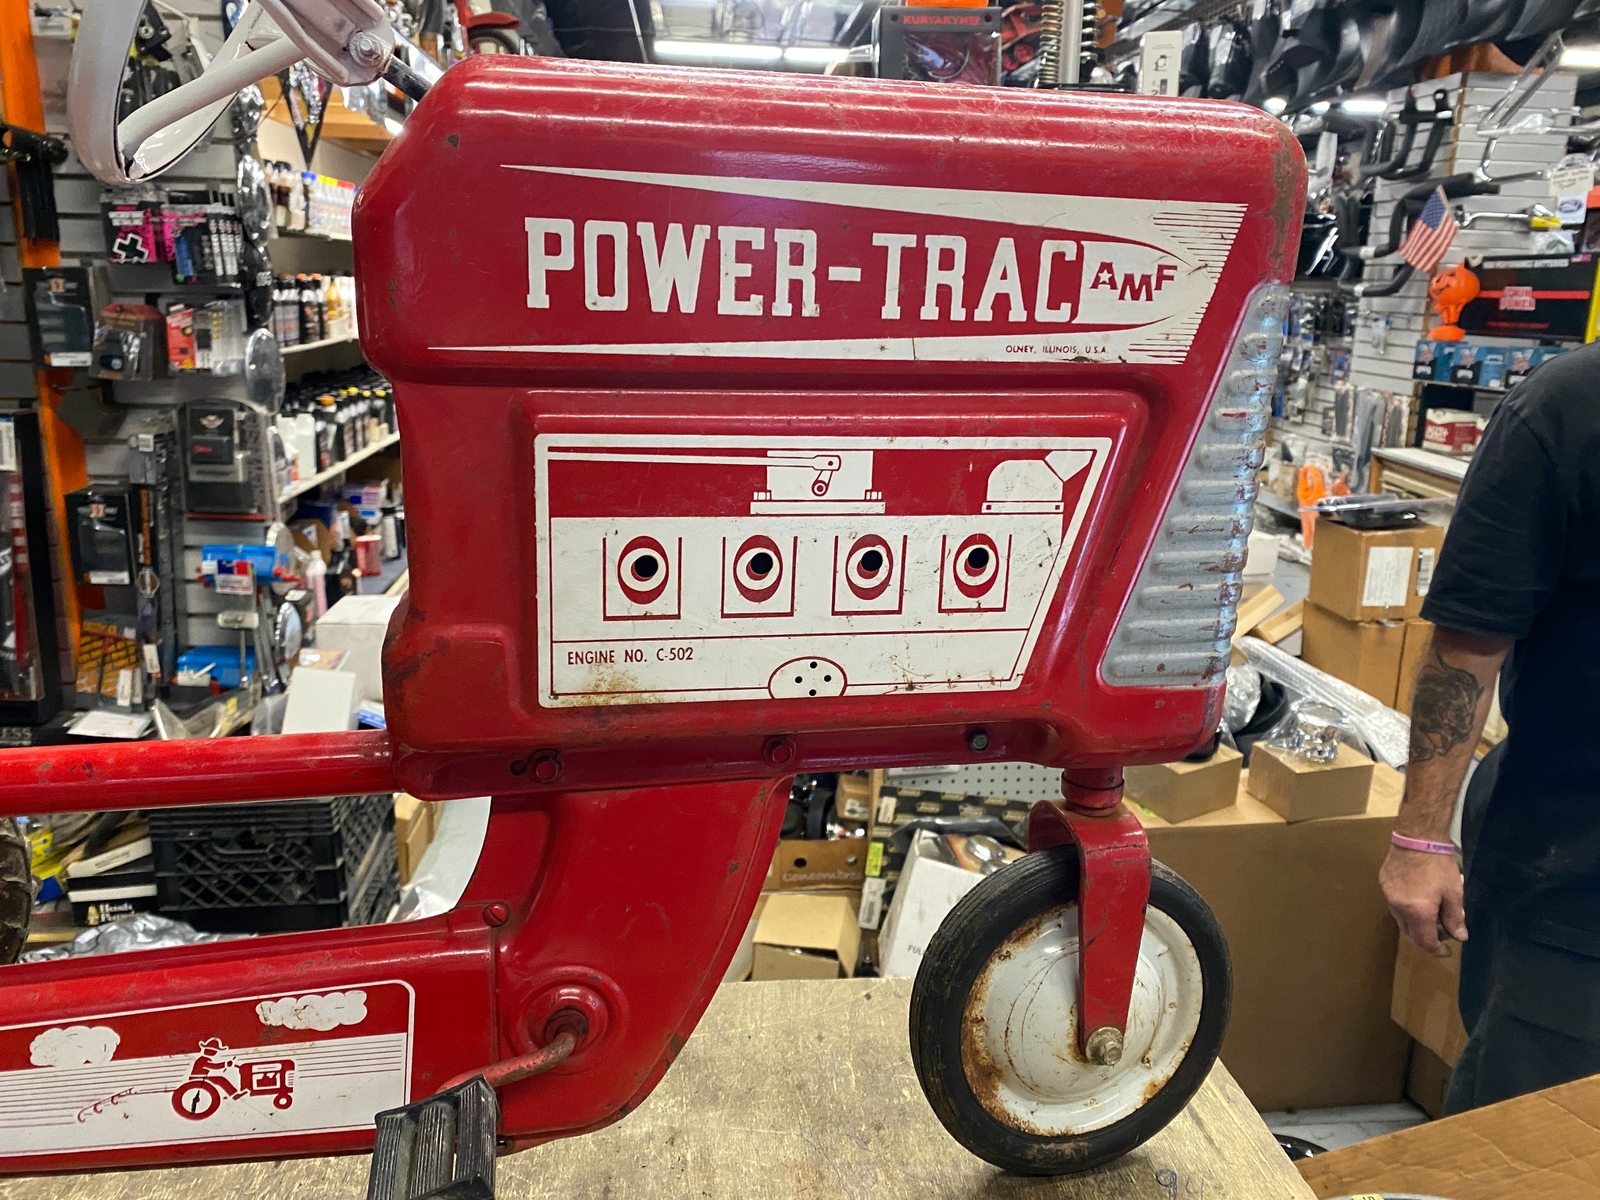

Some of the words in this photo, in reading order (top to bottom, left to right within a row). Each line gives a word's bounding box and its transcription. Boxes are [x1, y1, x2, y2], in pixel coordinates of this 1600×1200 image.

[524, 216, 1077, 323] POWER-TRAC
[1089, 261, 1178, 302] AMF
[567, 650, 615, 665] ENGINE
[624, 648, 648, 663] NO.
[656, 646, 693, 662] C-502
